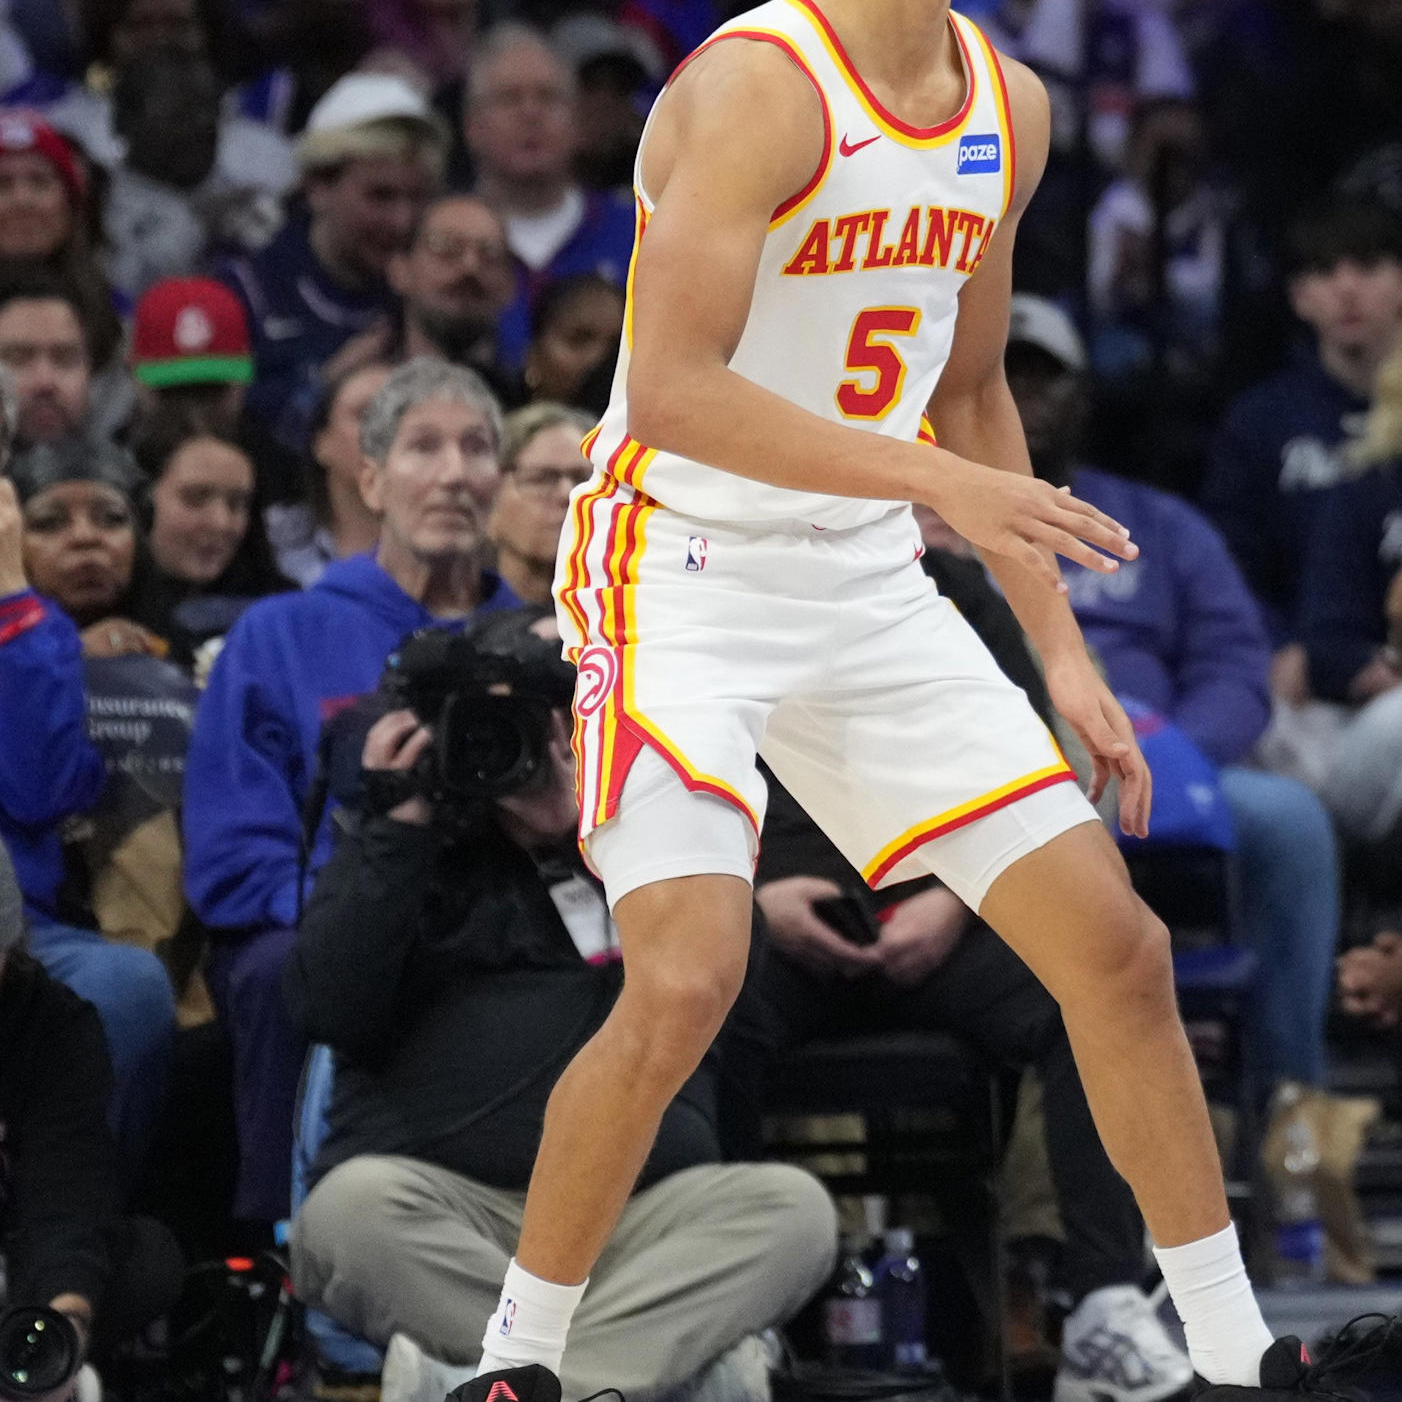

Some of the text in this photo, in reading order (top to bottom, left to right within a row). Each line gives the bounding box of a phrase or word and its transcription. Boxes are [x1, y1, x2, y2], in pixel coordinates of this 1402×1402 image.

[958, 142, 997, 166] paze
[778, 205, 998, 278] ATLANTA
[834, 305, 922, 422] 5
